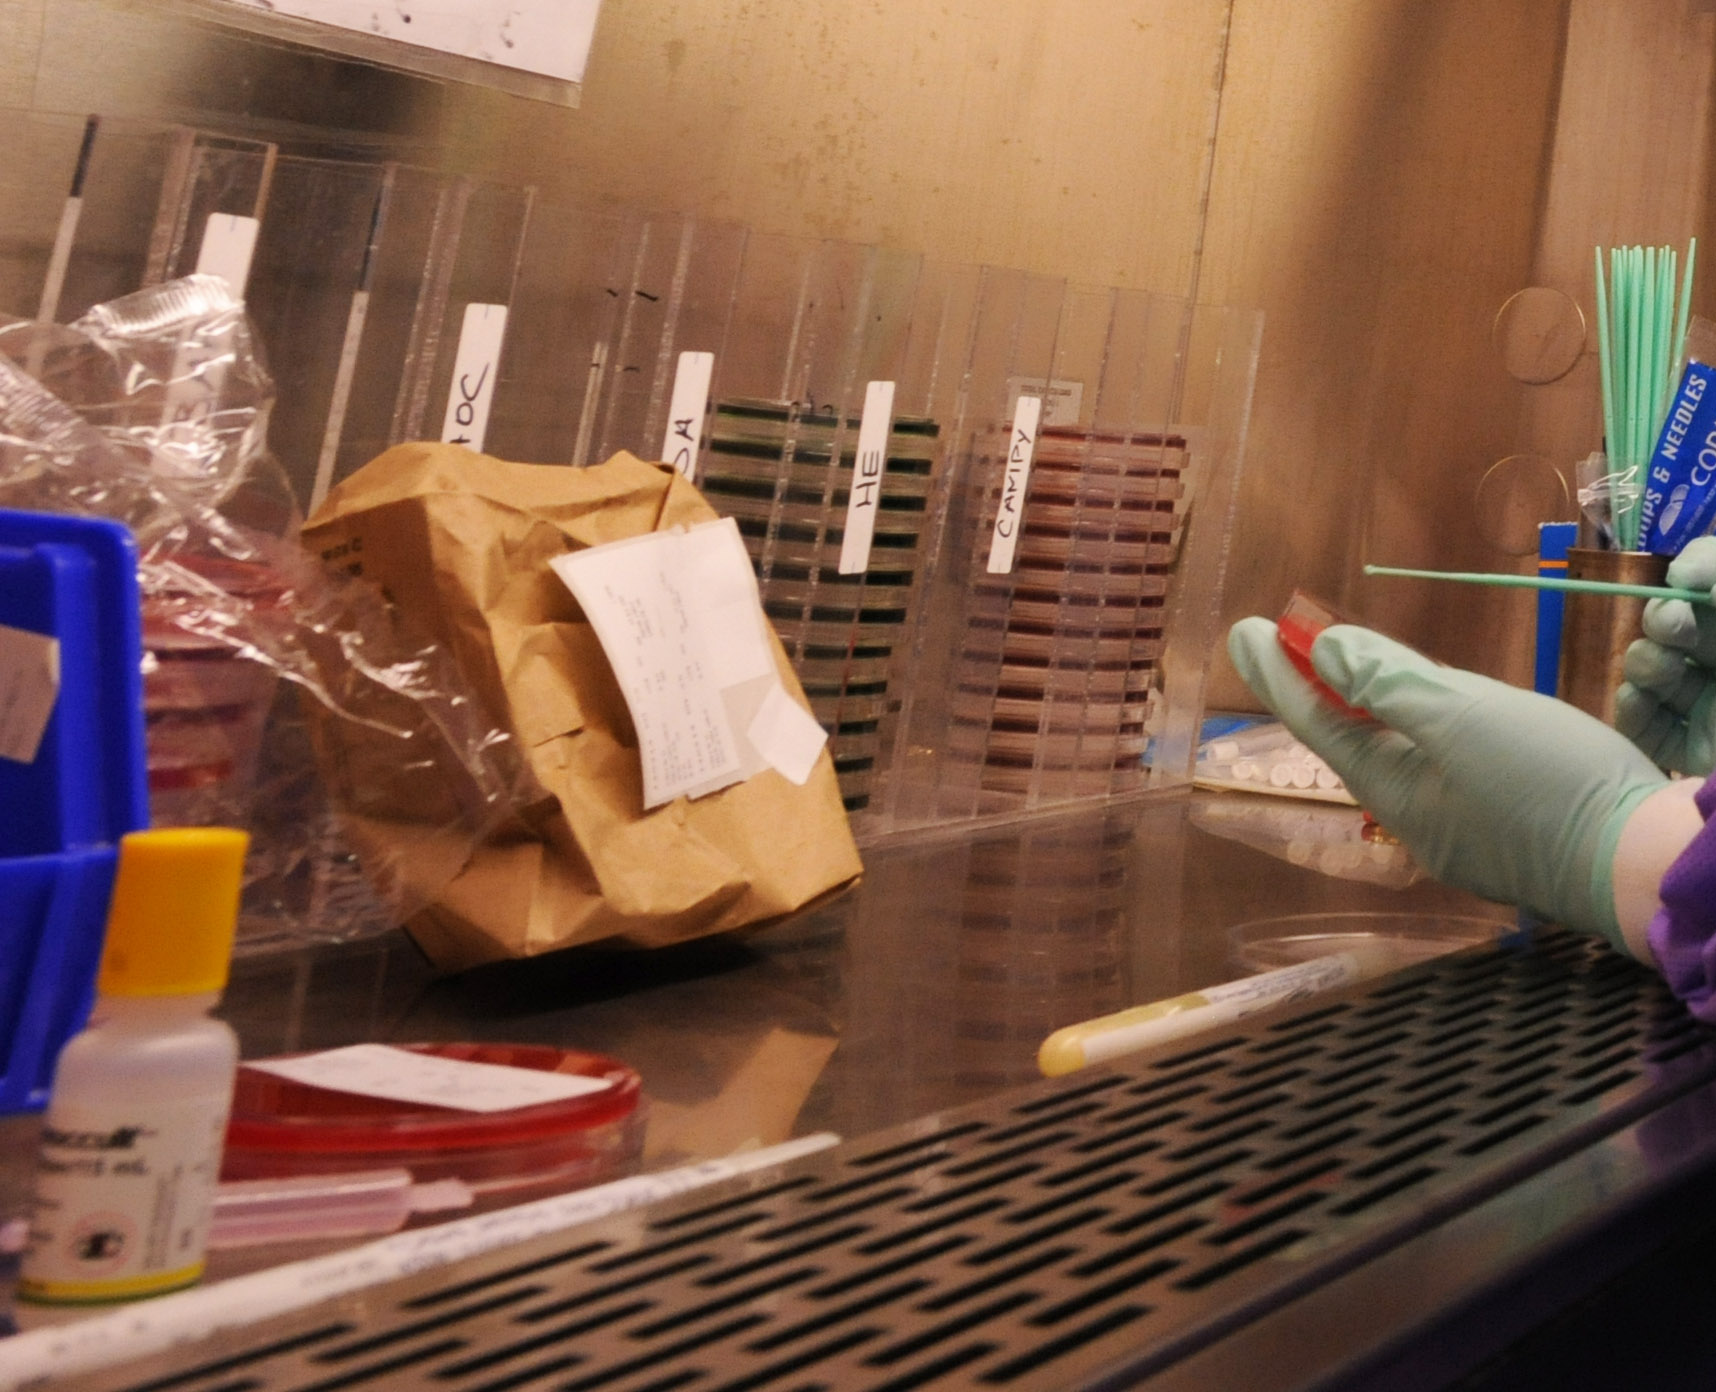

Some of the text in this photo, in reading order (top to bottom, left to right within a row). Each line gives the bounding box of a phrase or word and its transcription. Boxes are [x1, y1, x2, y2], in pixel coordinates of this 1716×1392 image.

[1661, 373, 1707, 461] NEEDLES
[855, 450, 880, 508] HE
[996, 428, 1032, 538] CAMPY
[1653, 465, 1671, 484] &
